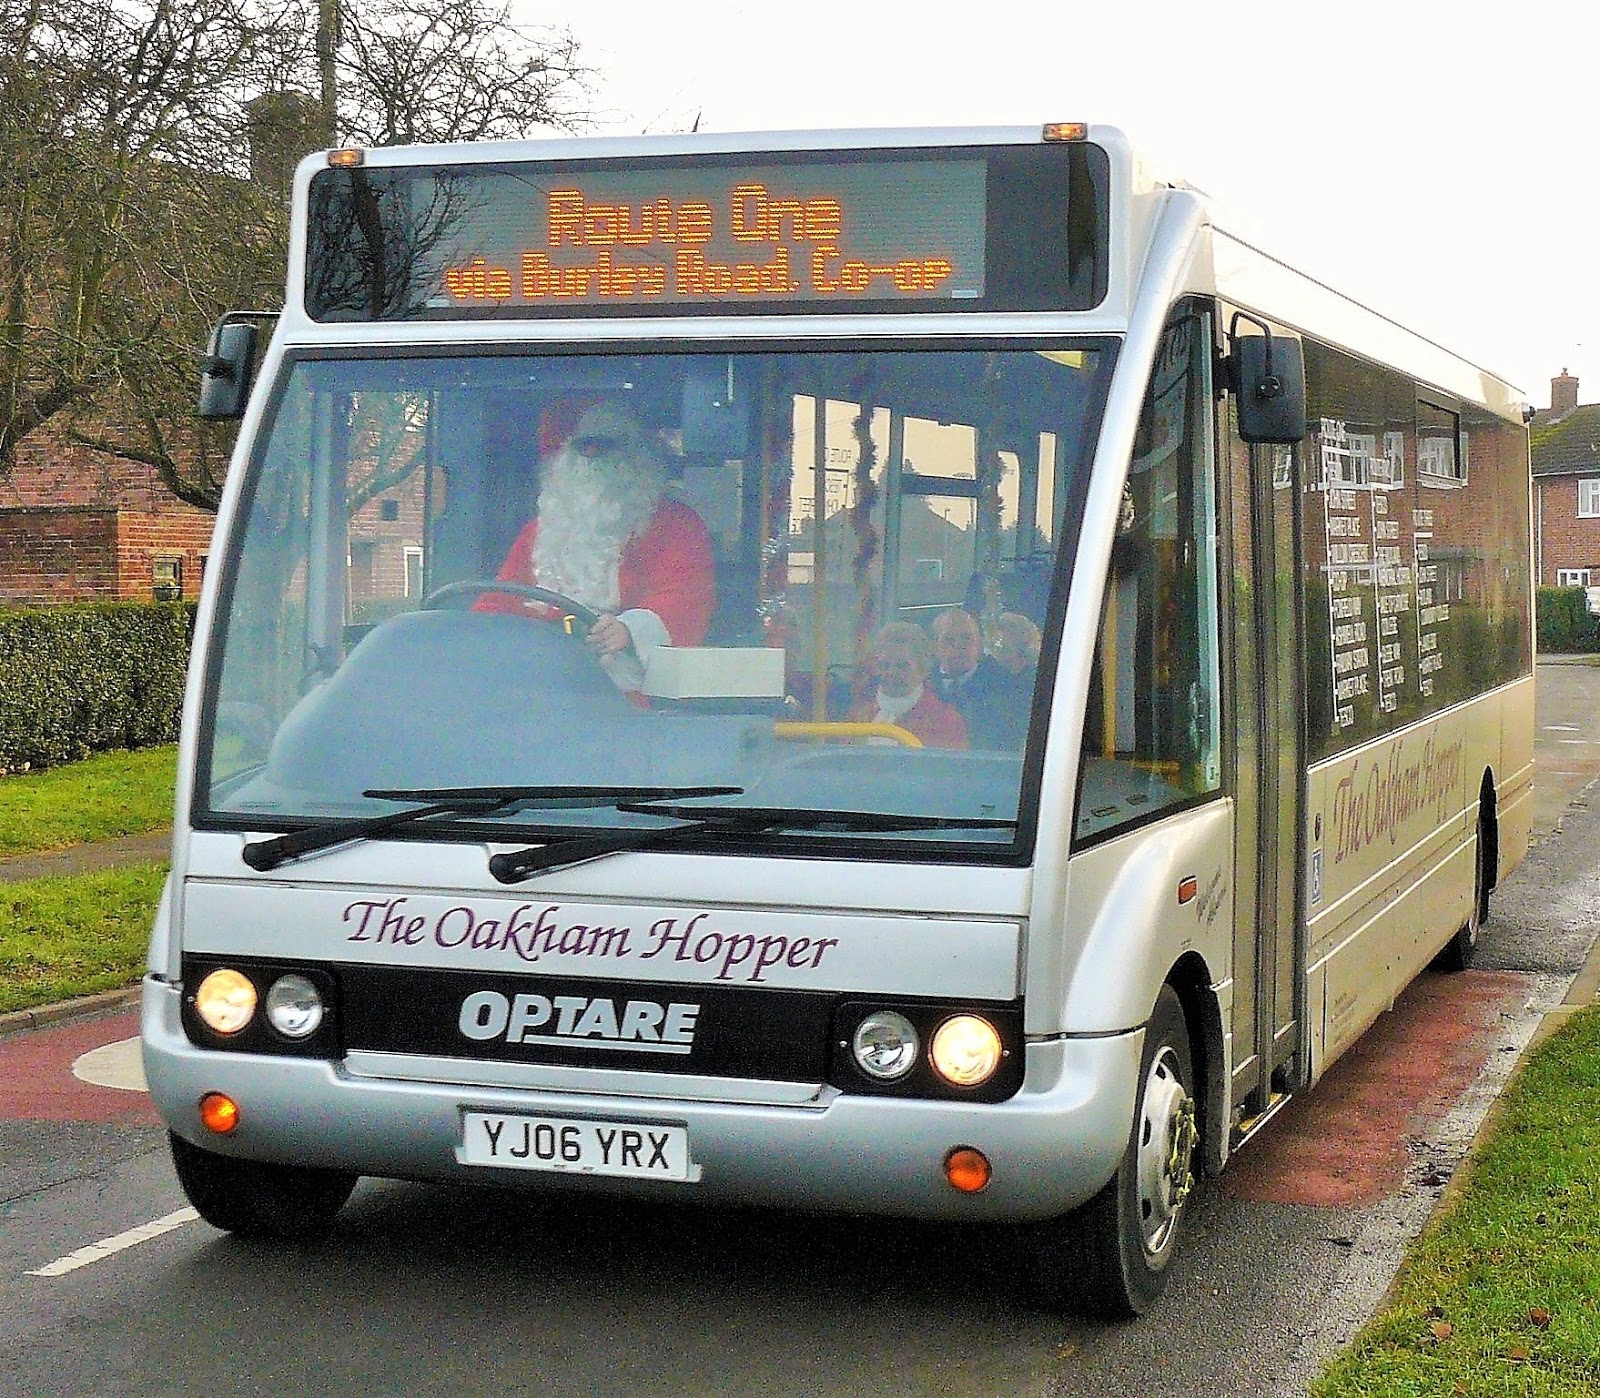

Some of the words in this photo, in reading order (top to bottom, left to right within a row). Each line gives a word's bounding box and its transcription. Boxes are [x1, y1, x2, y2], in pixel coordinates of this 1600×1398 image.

[548, 188, 713, 247] Route
[732, 183, 842, 242] One
[446, 258, 512, 300] via
[812, 244, 953, 293] Co-op
[342, 896, 425, 945] The
[434, 903, 632, 962] Oakham
[639, 912, 839, 983] Hopper
[458, 990, 701, 1054] OPTARE
[484, 1119, 581, 1162] YJ06
[596, 1127, 669, 1170] YRX
